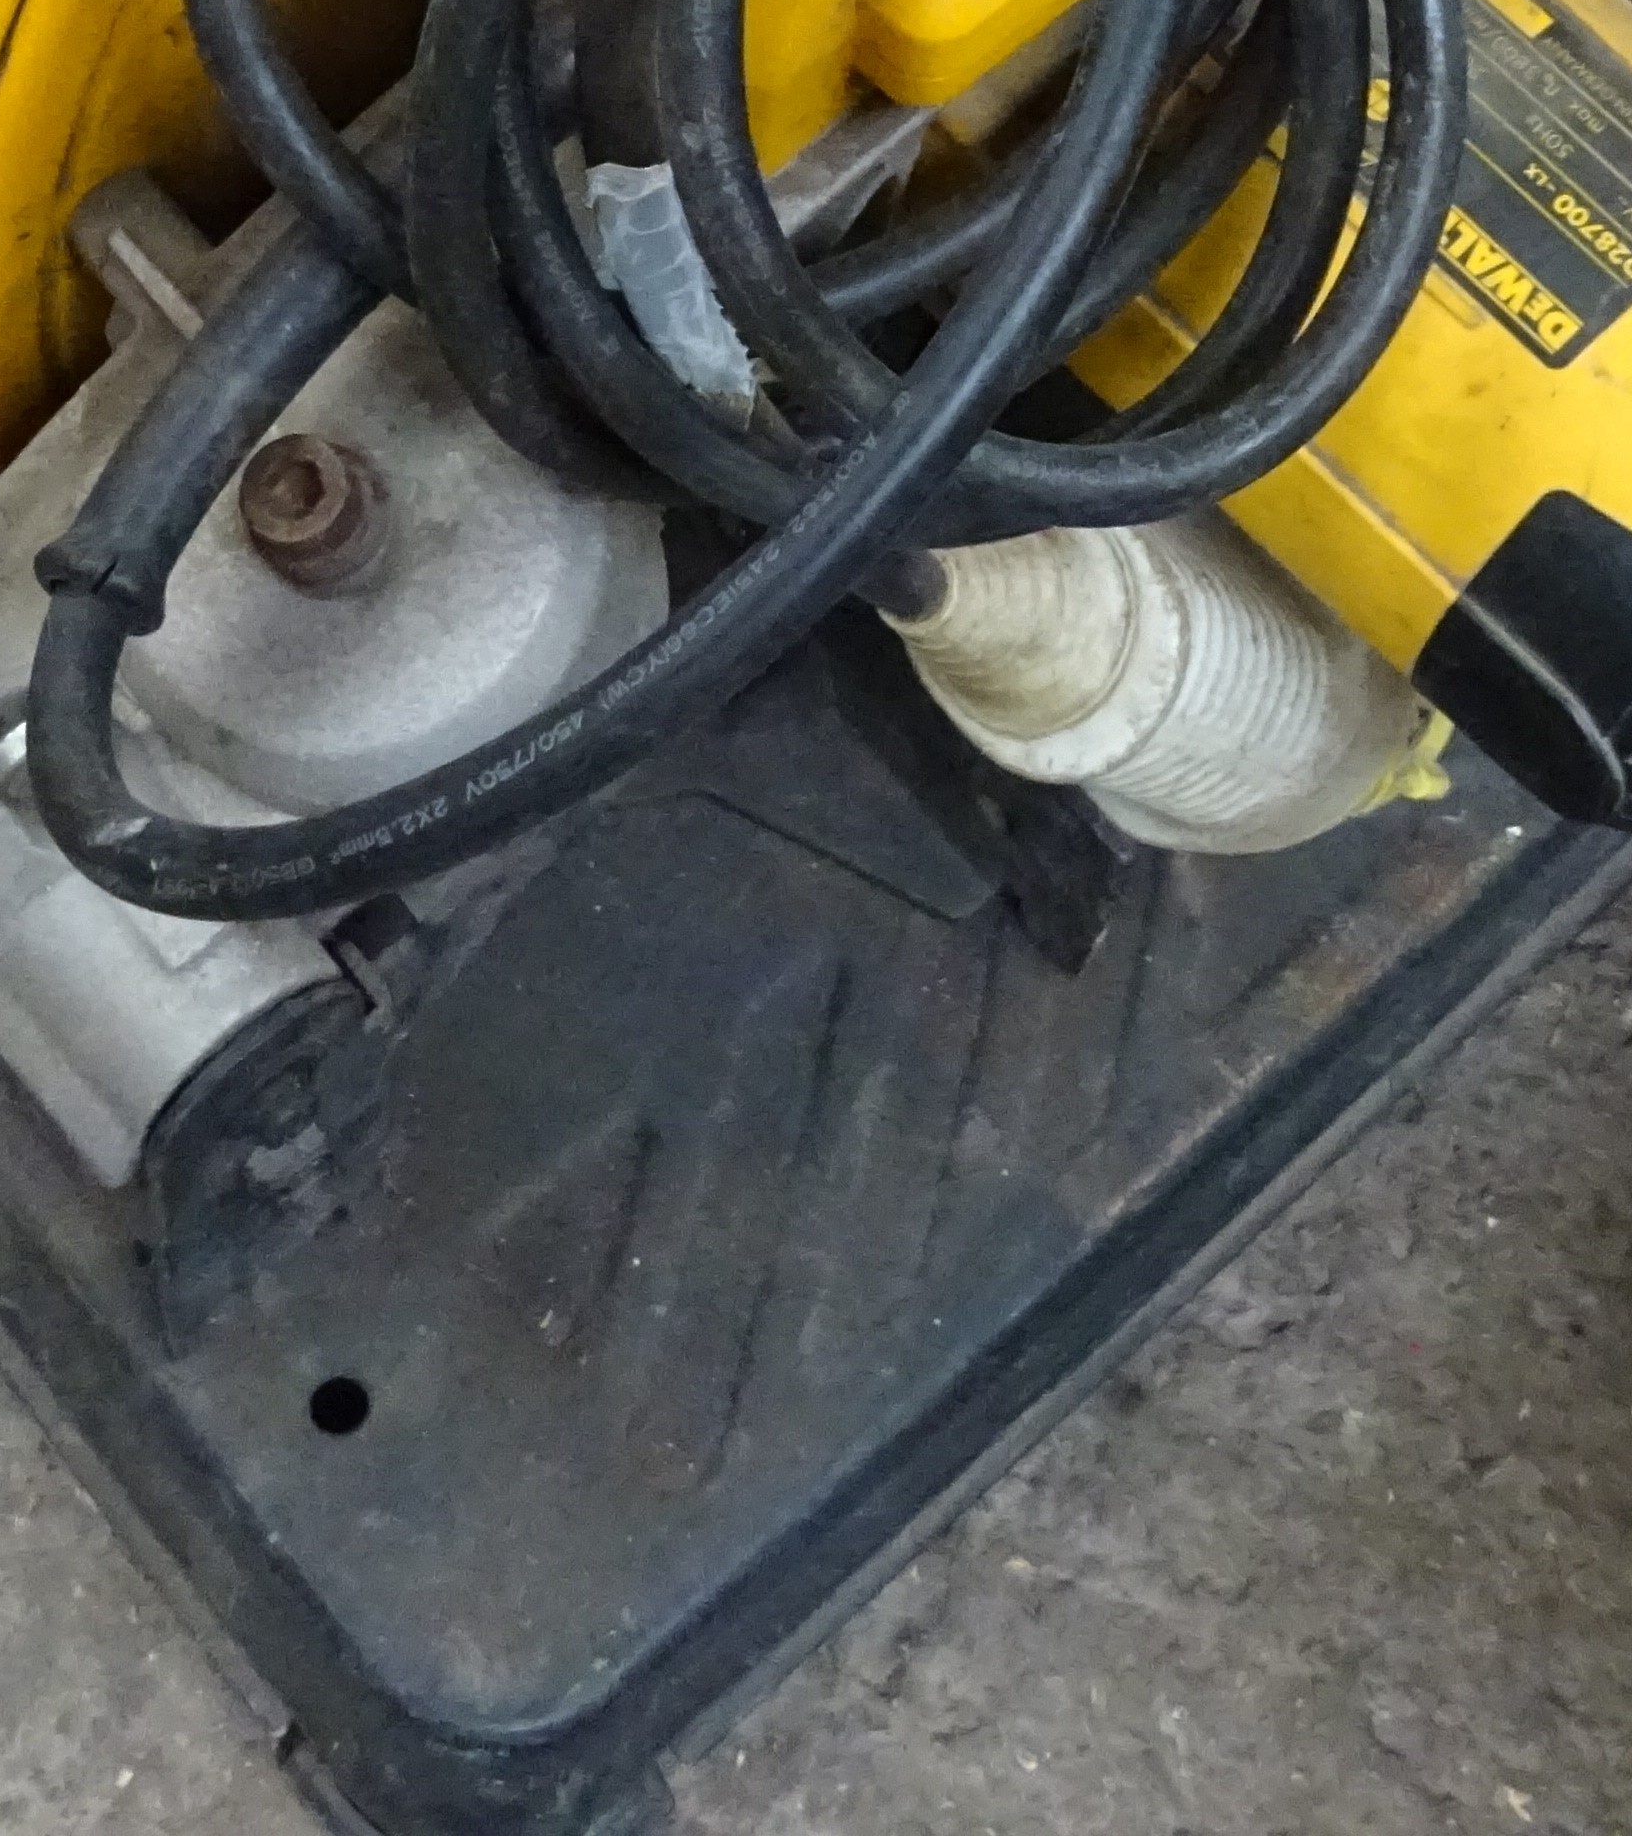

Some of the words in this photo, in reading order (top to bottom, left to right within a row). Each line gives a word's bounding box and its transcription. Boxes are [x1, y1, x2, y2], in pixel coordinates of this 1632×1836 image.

[1525, 114, 1575, 159] 50Hz
[1569, 100, 1606, 134] max
[465, 710, 585, 805] 450/750V
